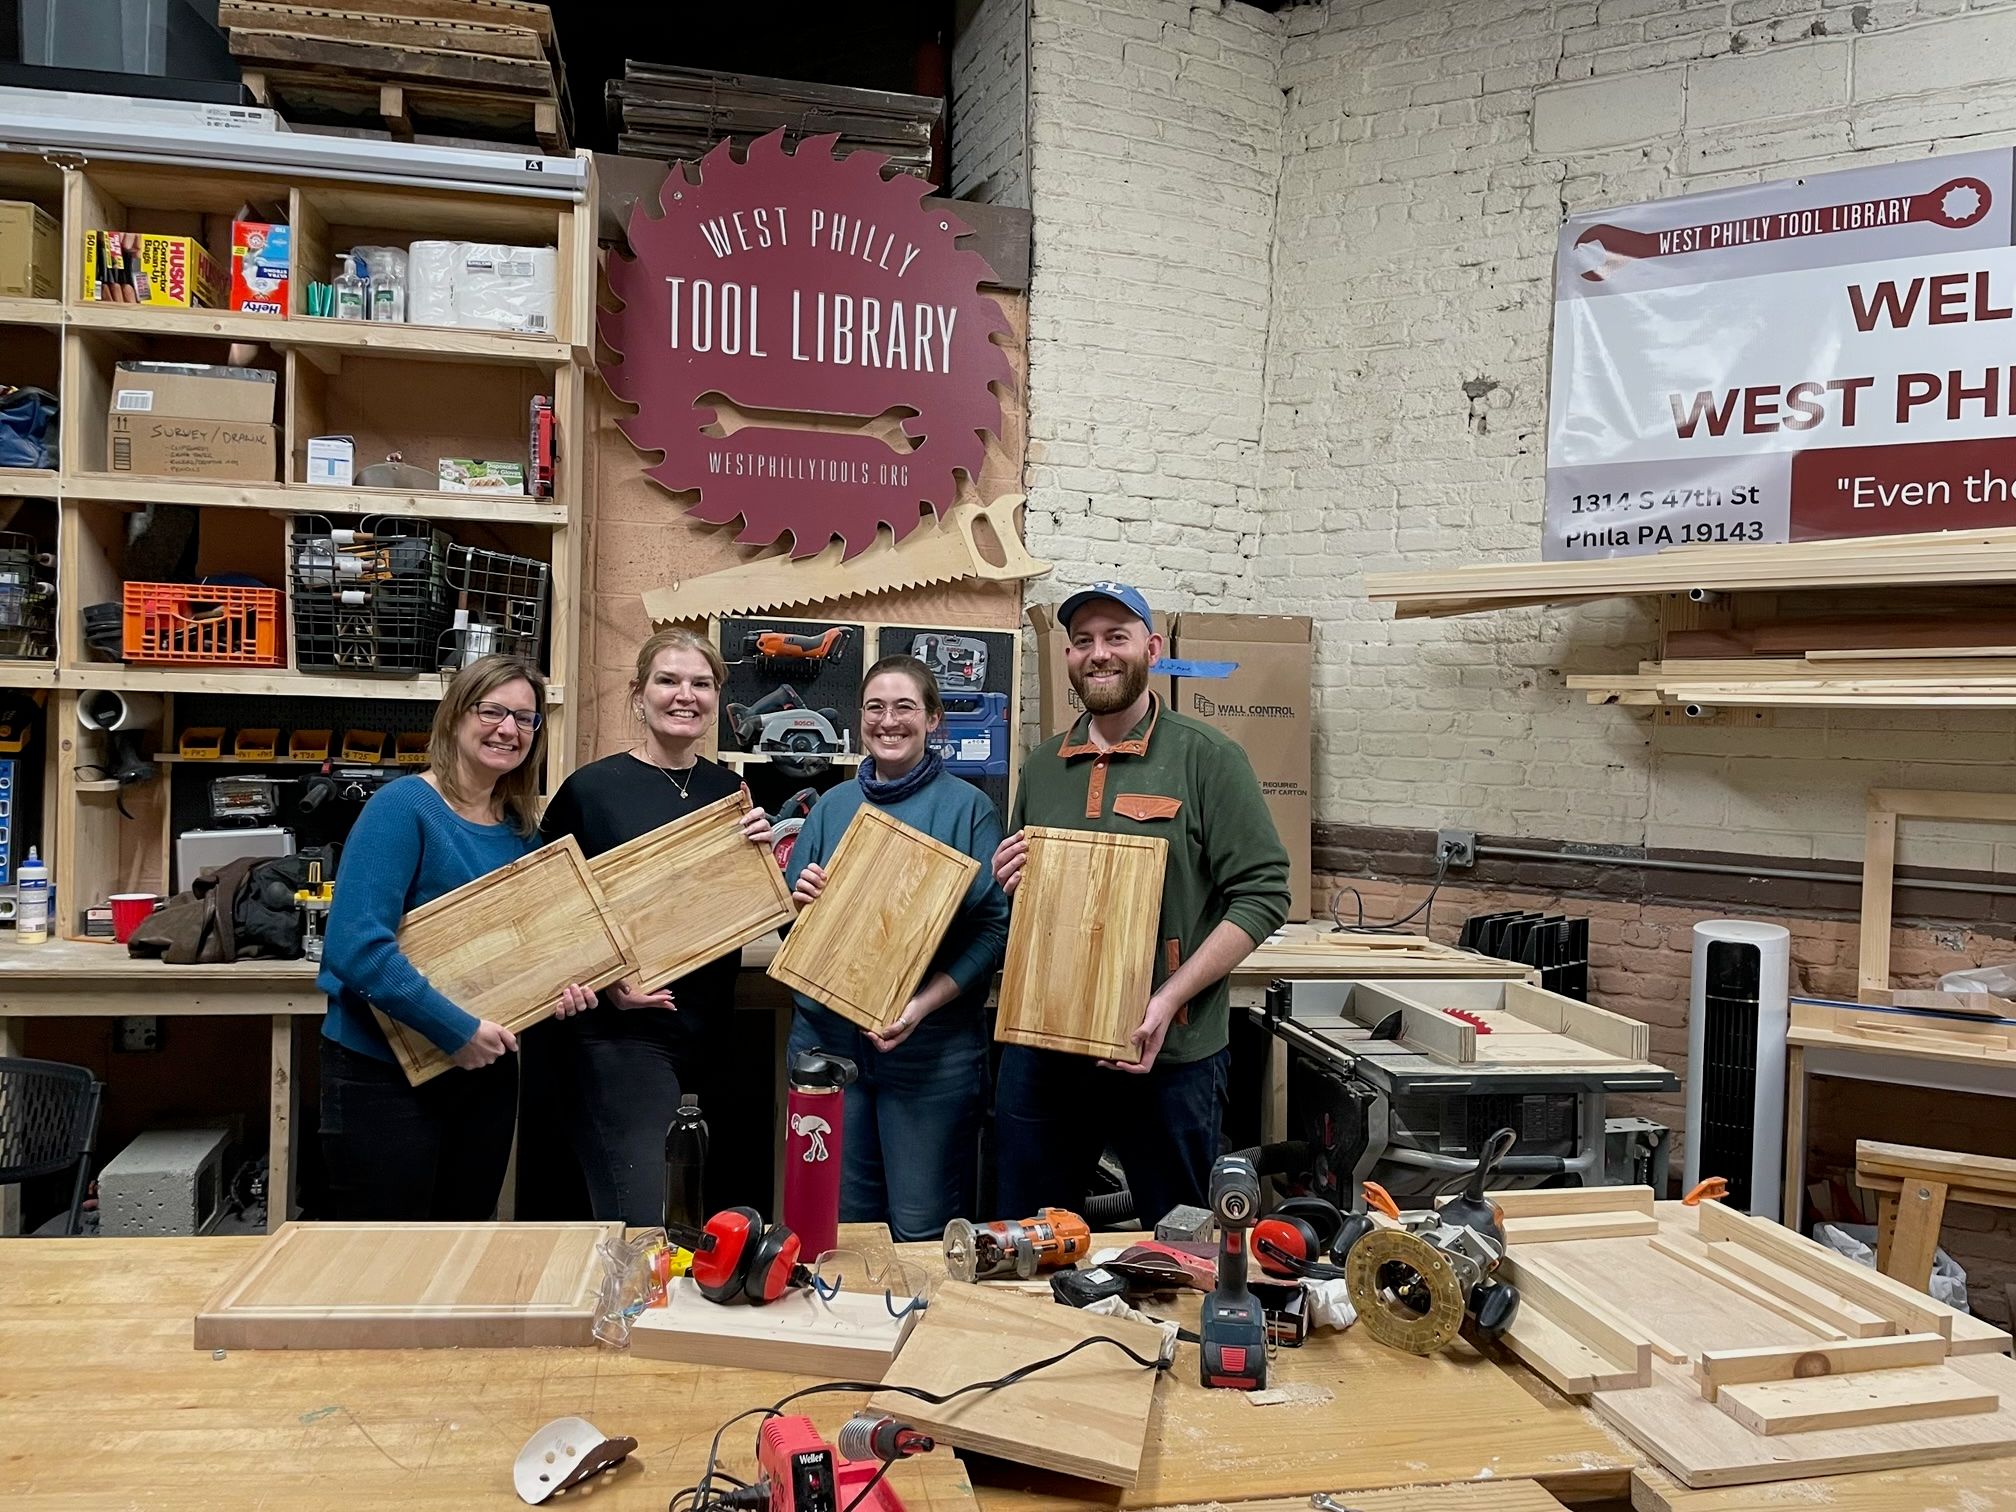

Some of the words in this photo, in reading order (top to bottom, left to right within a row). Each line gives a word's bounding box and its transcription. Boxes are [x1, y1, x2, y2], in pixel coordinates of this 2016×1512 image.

[1659, 227, 1703, 254] WEST
[1711, 216, 1770, 247] PHILLY
[1778, 209, 1823, 238] TOOL
[1832, 197, 1912, 231] LIBRARY
[143, 239, 153, 265] Bags
[698, 206, 788, 259] WEST
[810, 209, 920, 278] PHILLY
[151, 239, 161, 284] Clean-Up
[160, 240, 169, 294] Contractor
[169, 241, 185, 303] HUSKY
[244, 301, 279, 315] Hefty
[665, 276, 768, 358] TOOL
[791, 289, 959, 374] LIBRARY
[1669, 376, 1875, 440] WEST
[150, 424, 208, 440] SURVEY
[708, 451, 910, 488] WESTPHILLYTOOLS.ORG
[1571, 492, 1632, 514] 1314
[1639, 490, 1655, 510] S
[1661, 485, 1722, 508] 47th
[1730, 485, 1760, 506] St
[1837, 476, 1951, 509] "Even
[1638, 524, 1674, 544] PA
[1681, 520, 1764, 543] 19143
[793, 719, 815, 727] BOSCH
[1218, 704, 1246, 714] WALL
[1248, 705, 1295, 716] CONTROL
[1262, 781, 1298, 789] REQUIRED
[799, 1452, 824, 1465] Weller
